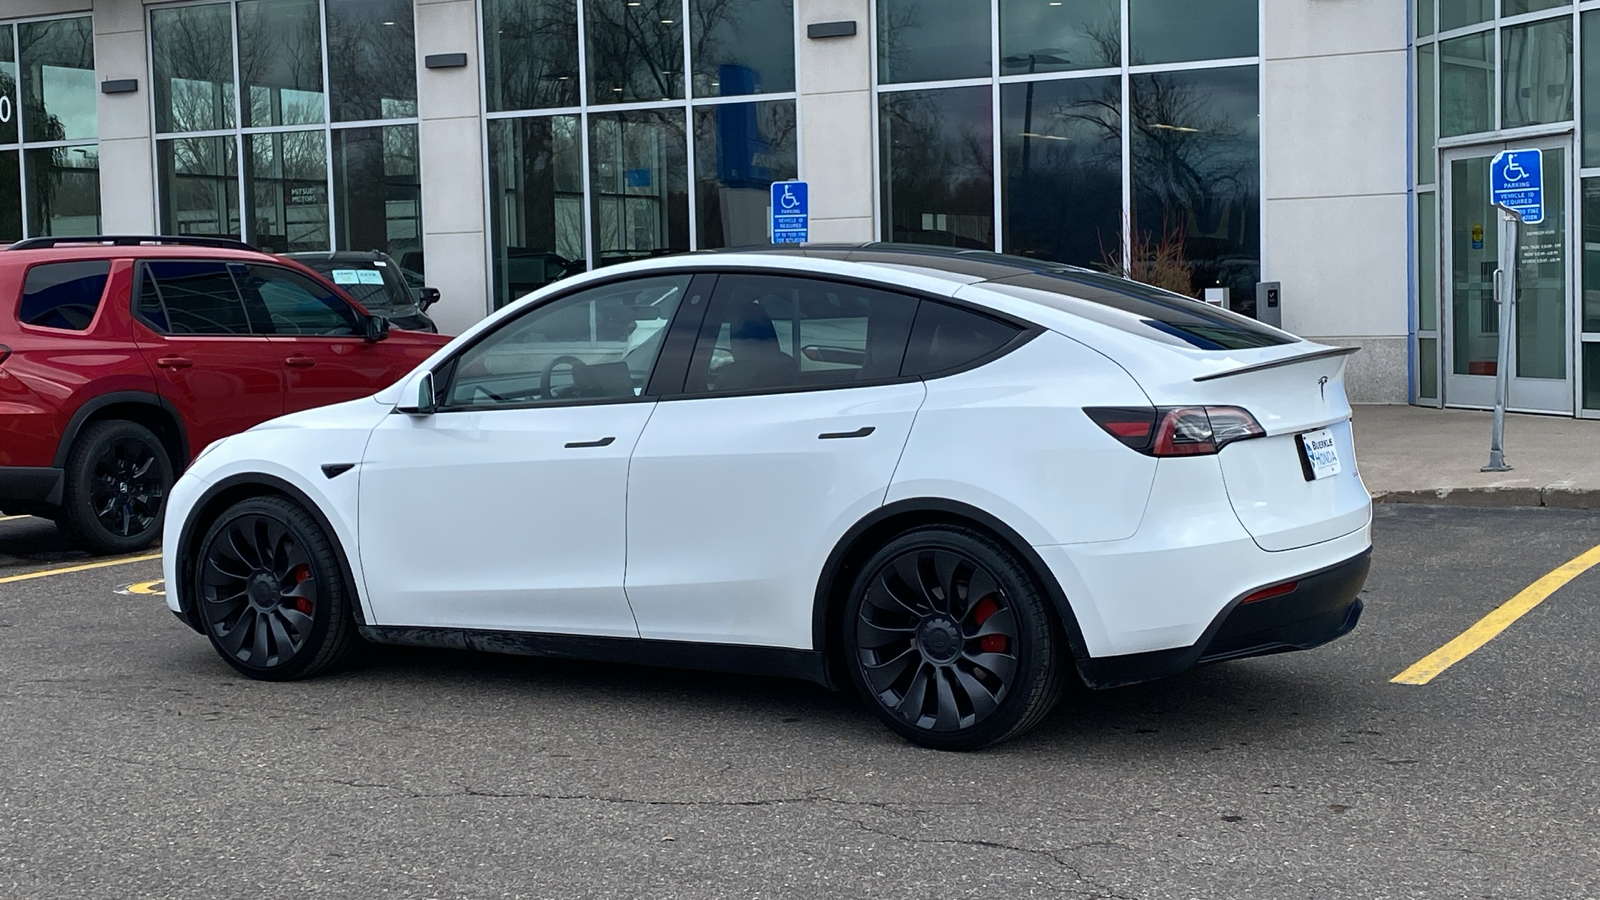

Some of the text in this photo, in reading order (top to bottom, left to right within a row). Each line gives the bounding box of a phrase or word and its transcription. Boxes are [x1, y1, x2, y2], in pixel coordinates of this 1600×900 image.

[1503, 181, 1530, 189] PARKING
[1500, 192, 1525, 200] VEHICLE
[1502, 198, 1533, 206] REQUIRED
[1311, 438, 1334, 451] BUERKLE
[1314, 450, 1338, 467] HONDA
